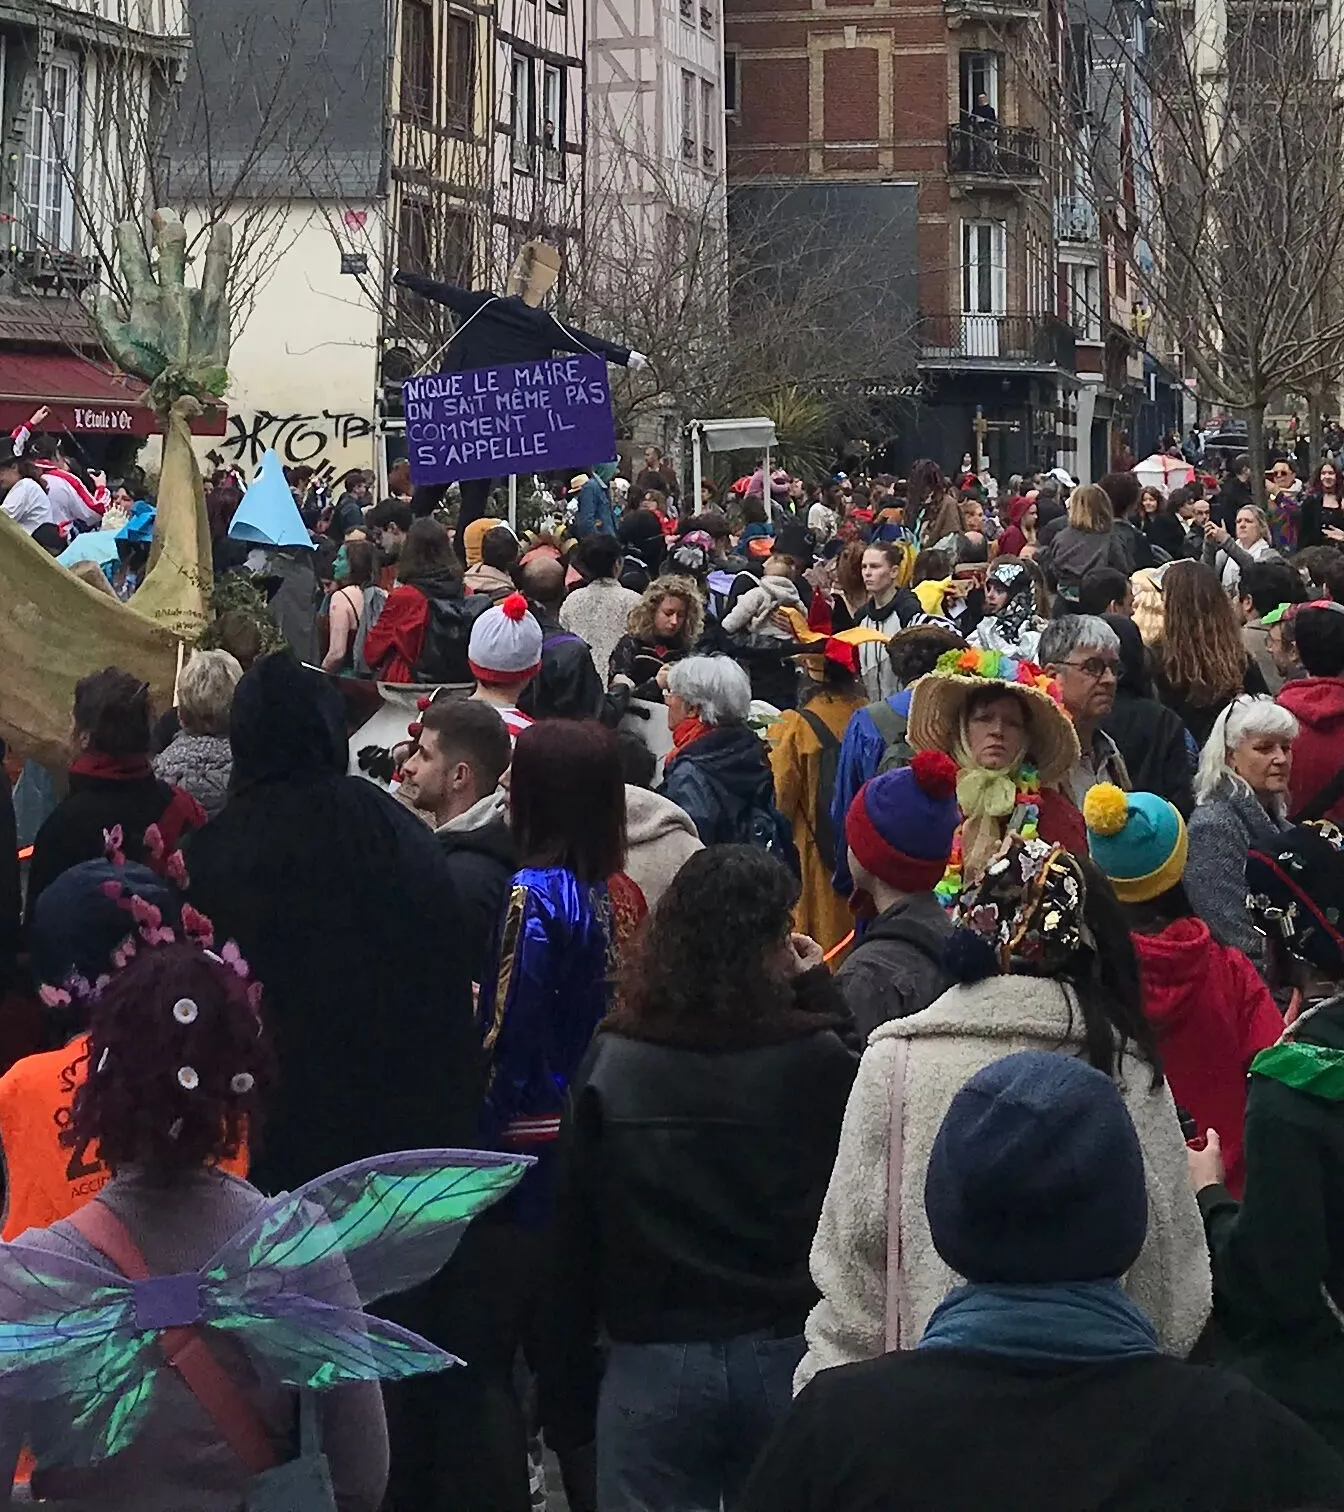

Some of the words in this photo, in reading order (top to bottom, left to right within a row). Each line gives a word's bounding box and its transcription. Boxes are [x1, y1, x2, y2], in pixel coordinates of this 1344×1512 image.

[474, 372, 499, 392] LE
[407, 402, 433, 420] ON
[496, 389, 552, 411] MÊME
[566, 382, 606, 406] PAS
[111, 410, 133, 429] d'Or
[409, 415, 527, 442] COMMENT
[548, 409, 576, 432] IL
[418, 433, 548, 466] S'APPELLE
